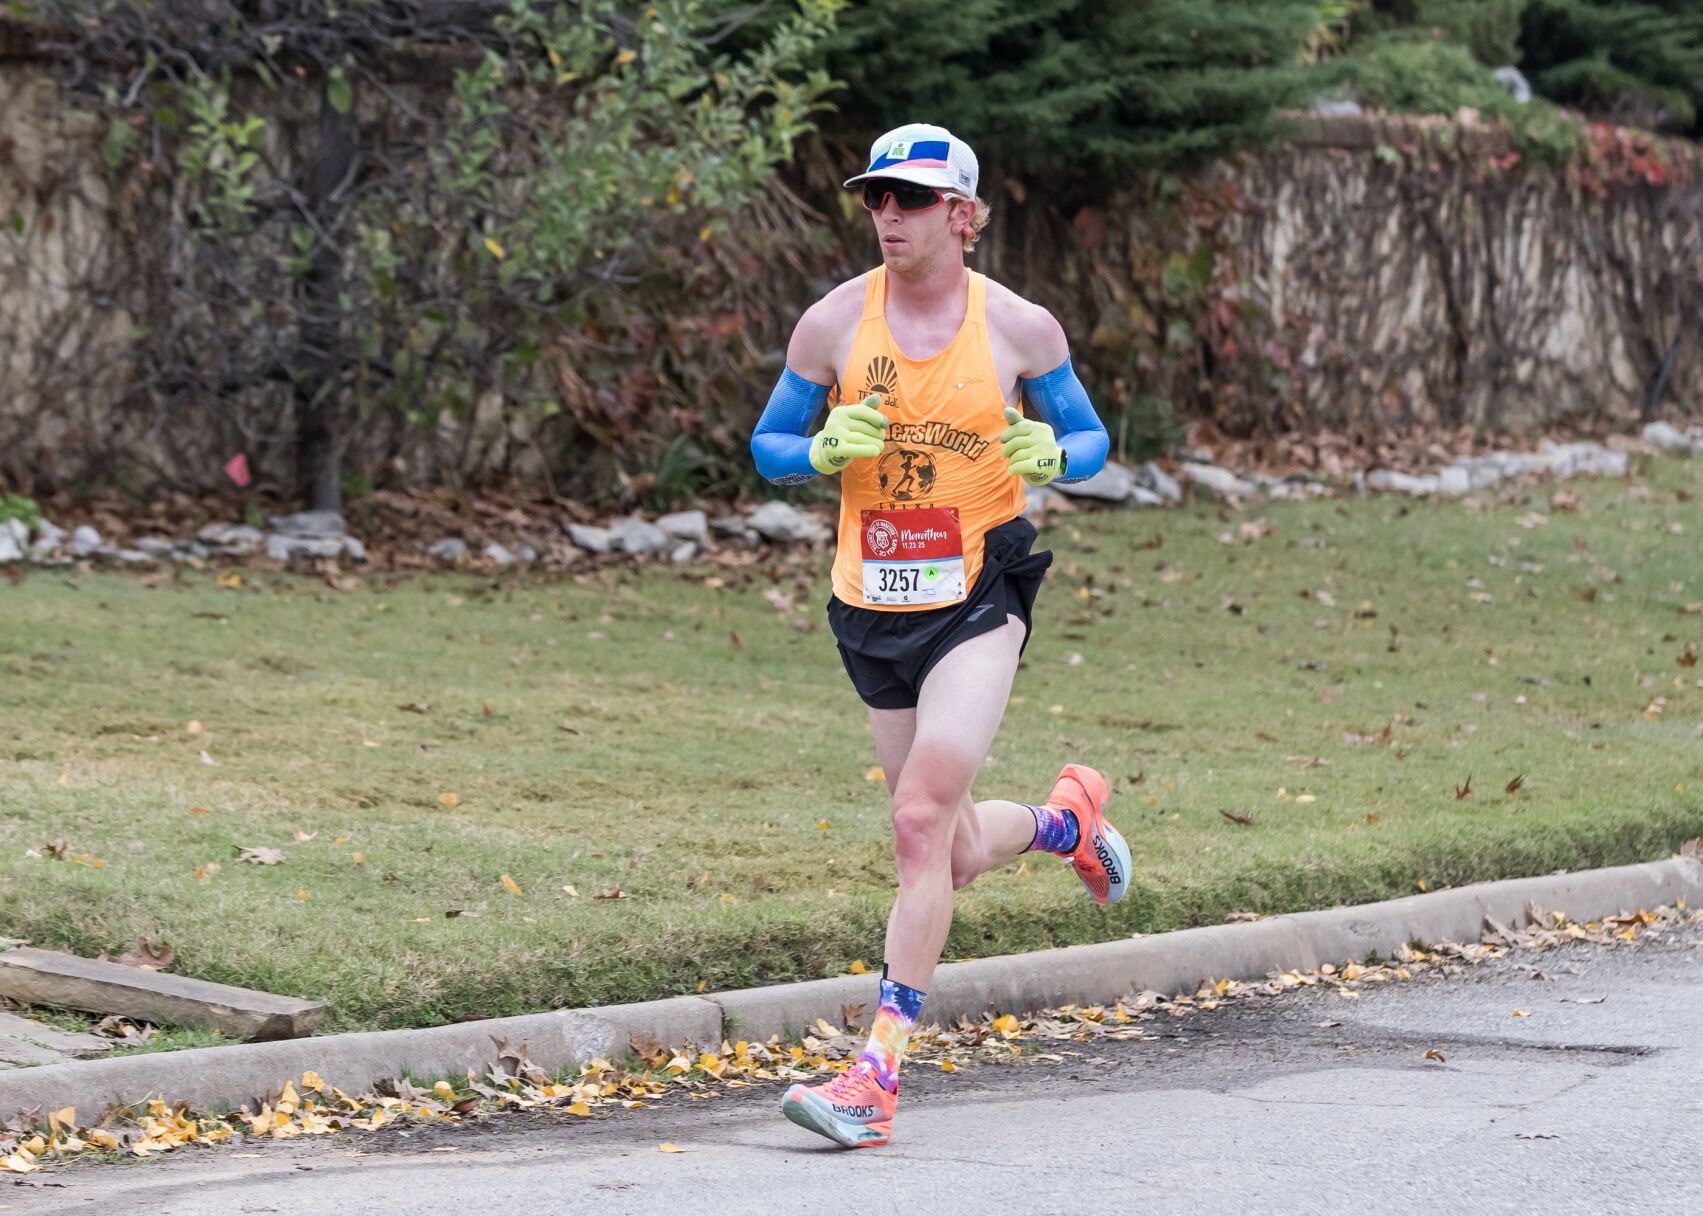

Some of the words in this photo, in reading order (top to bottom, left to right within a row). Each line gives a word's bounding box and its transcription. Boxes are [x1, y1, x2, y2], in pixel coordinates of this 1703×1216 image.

[886, 421, 990, 462] ersWorld
[901, 528, 947, 541] Marathon
[902, 541, 926, 549] 11.23.25
[878, 568, 920, 592] 3257
[928, 569, 935, 577] A
[1092, 834, 1122, 885] BROOKS
[832, 1103, 875, 1118] BROOKS
